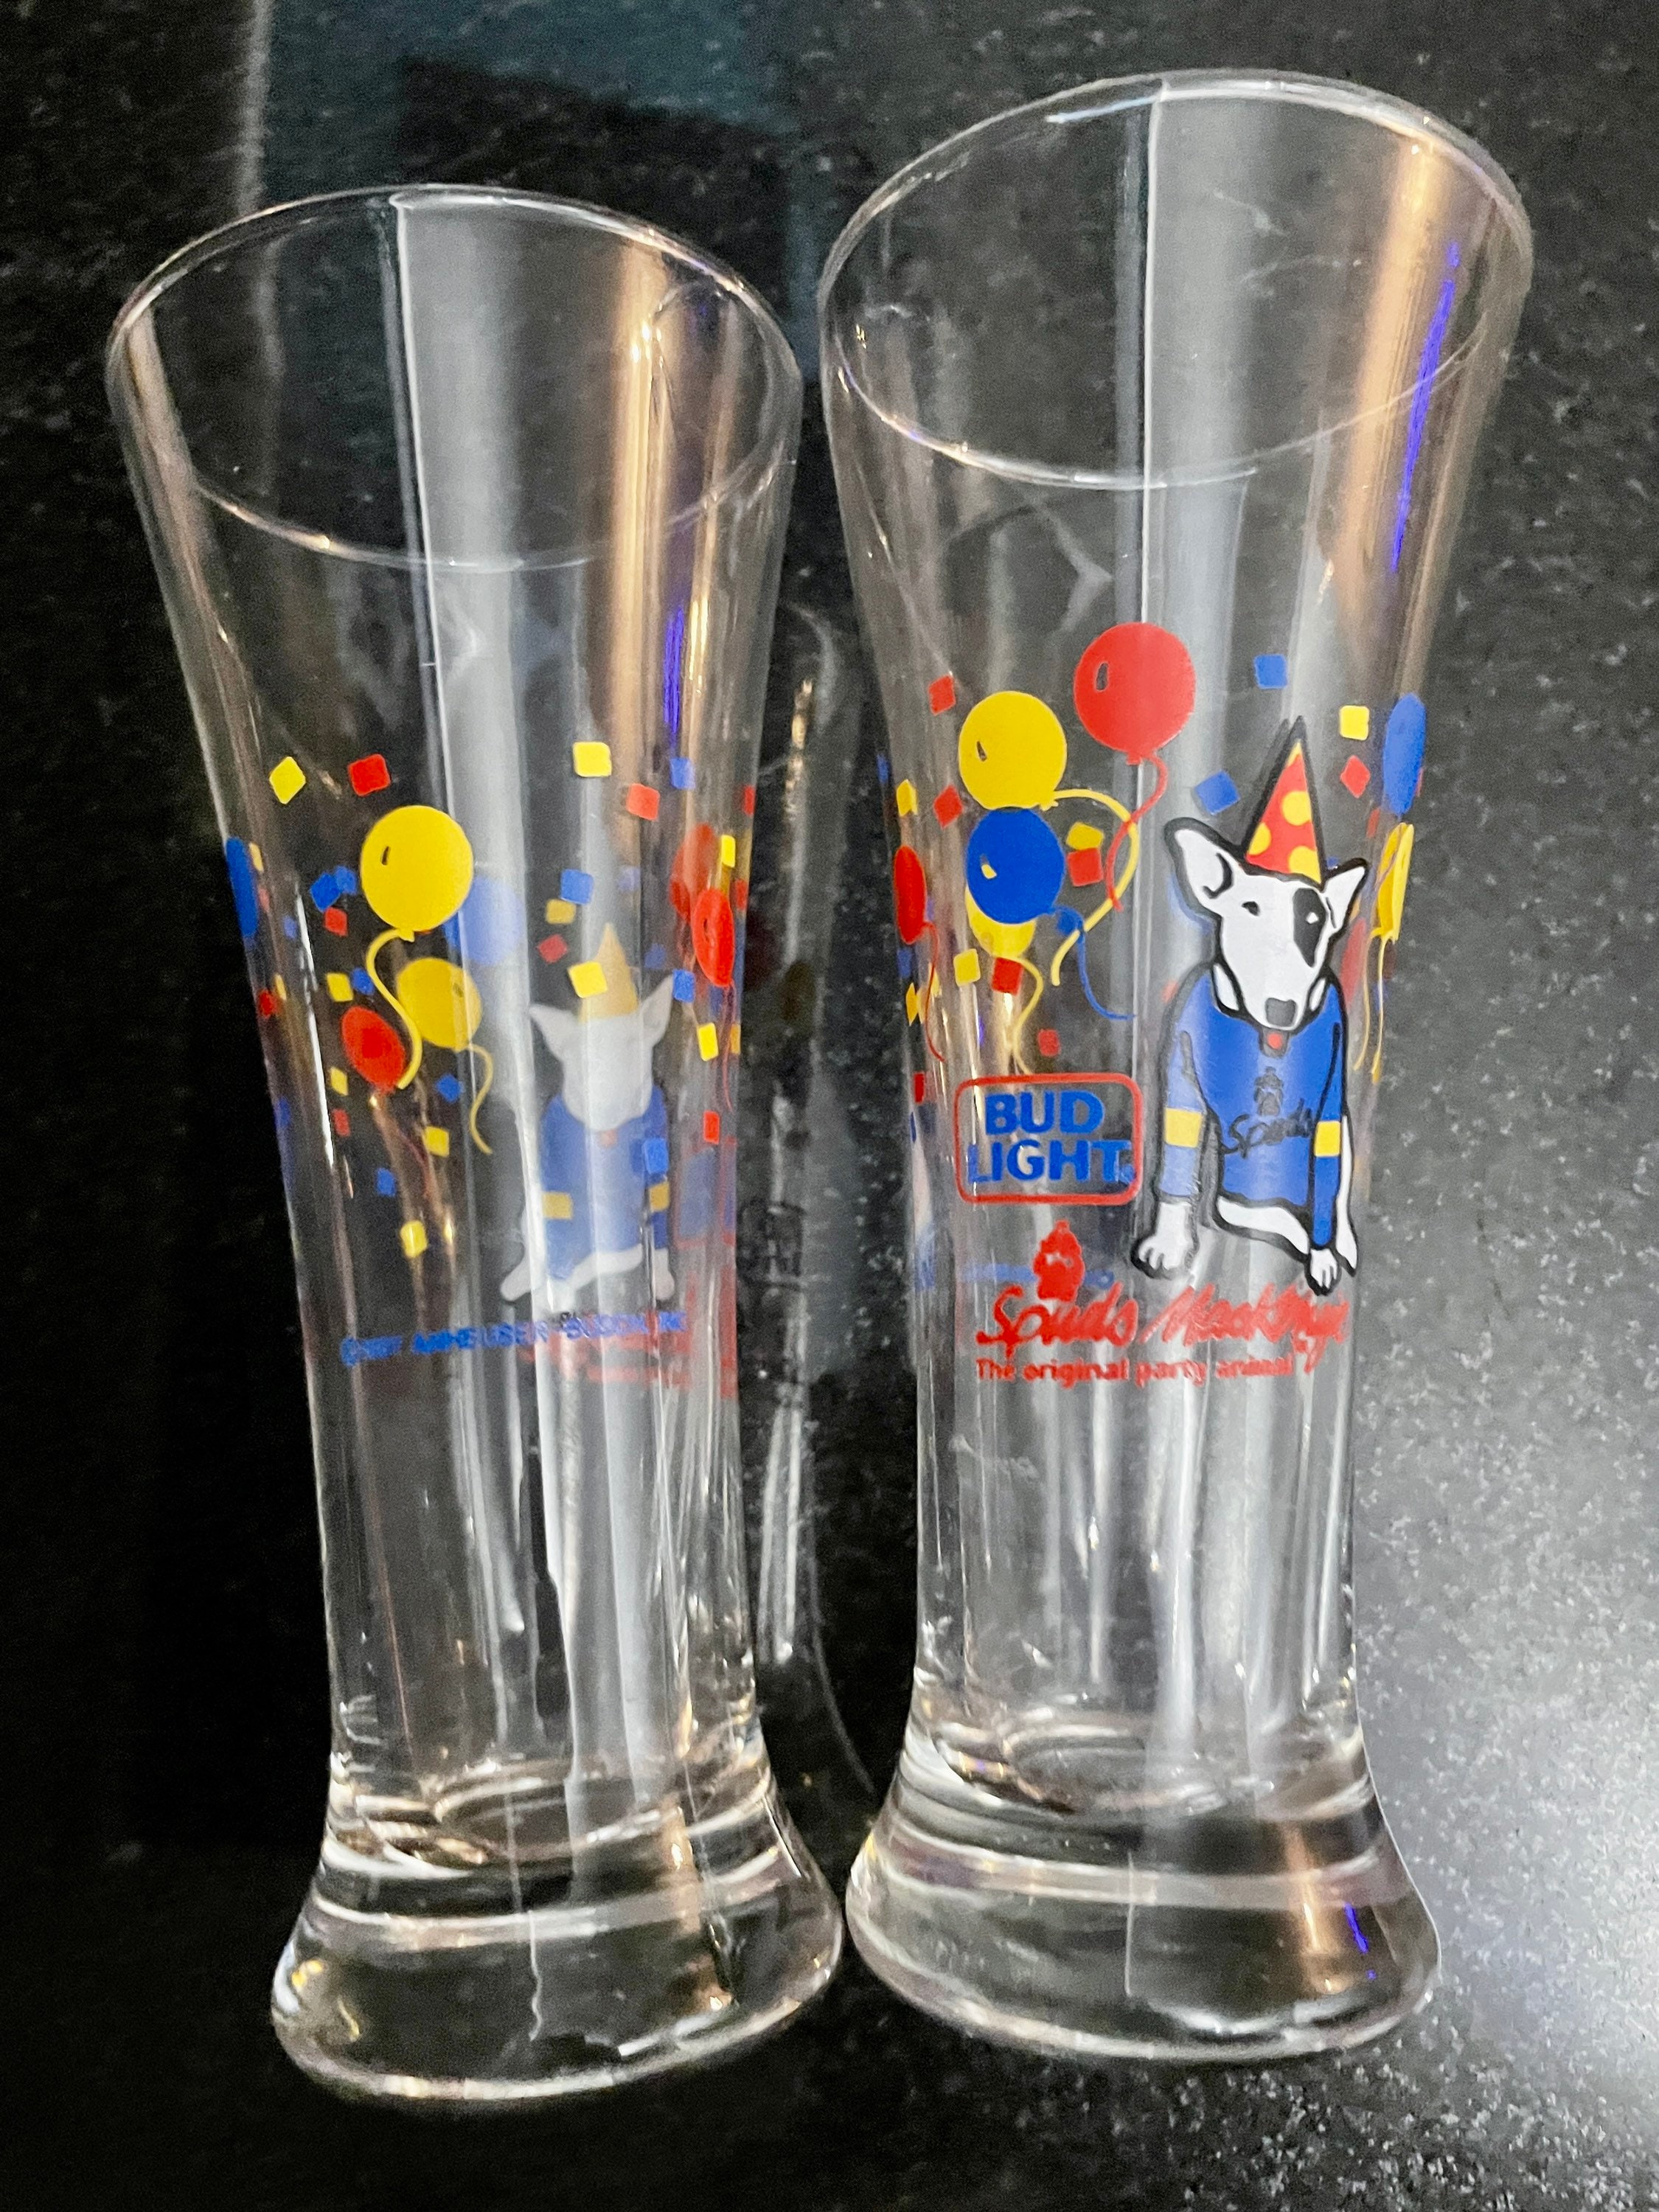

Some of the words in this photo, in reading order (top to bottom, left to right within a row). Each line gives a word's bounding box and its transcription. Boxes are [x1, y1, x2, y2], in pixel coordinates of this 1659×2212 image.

[985, 1090, 1105, 1135] BUD
[967, 1138, 1133, 1183] LIGHT
[975, 1357, 1015, 1382] The
[1022, 1357, 1130, 1389] original
[1133, 1359, 1207, 1388] party
